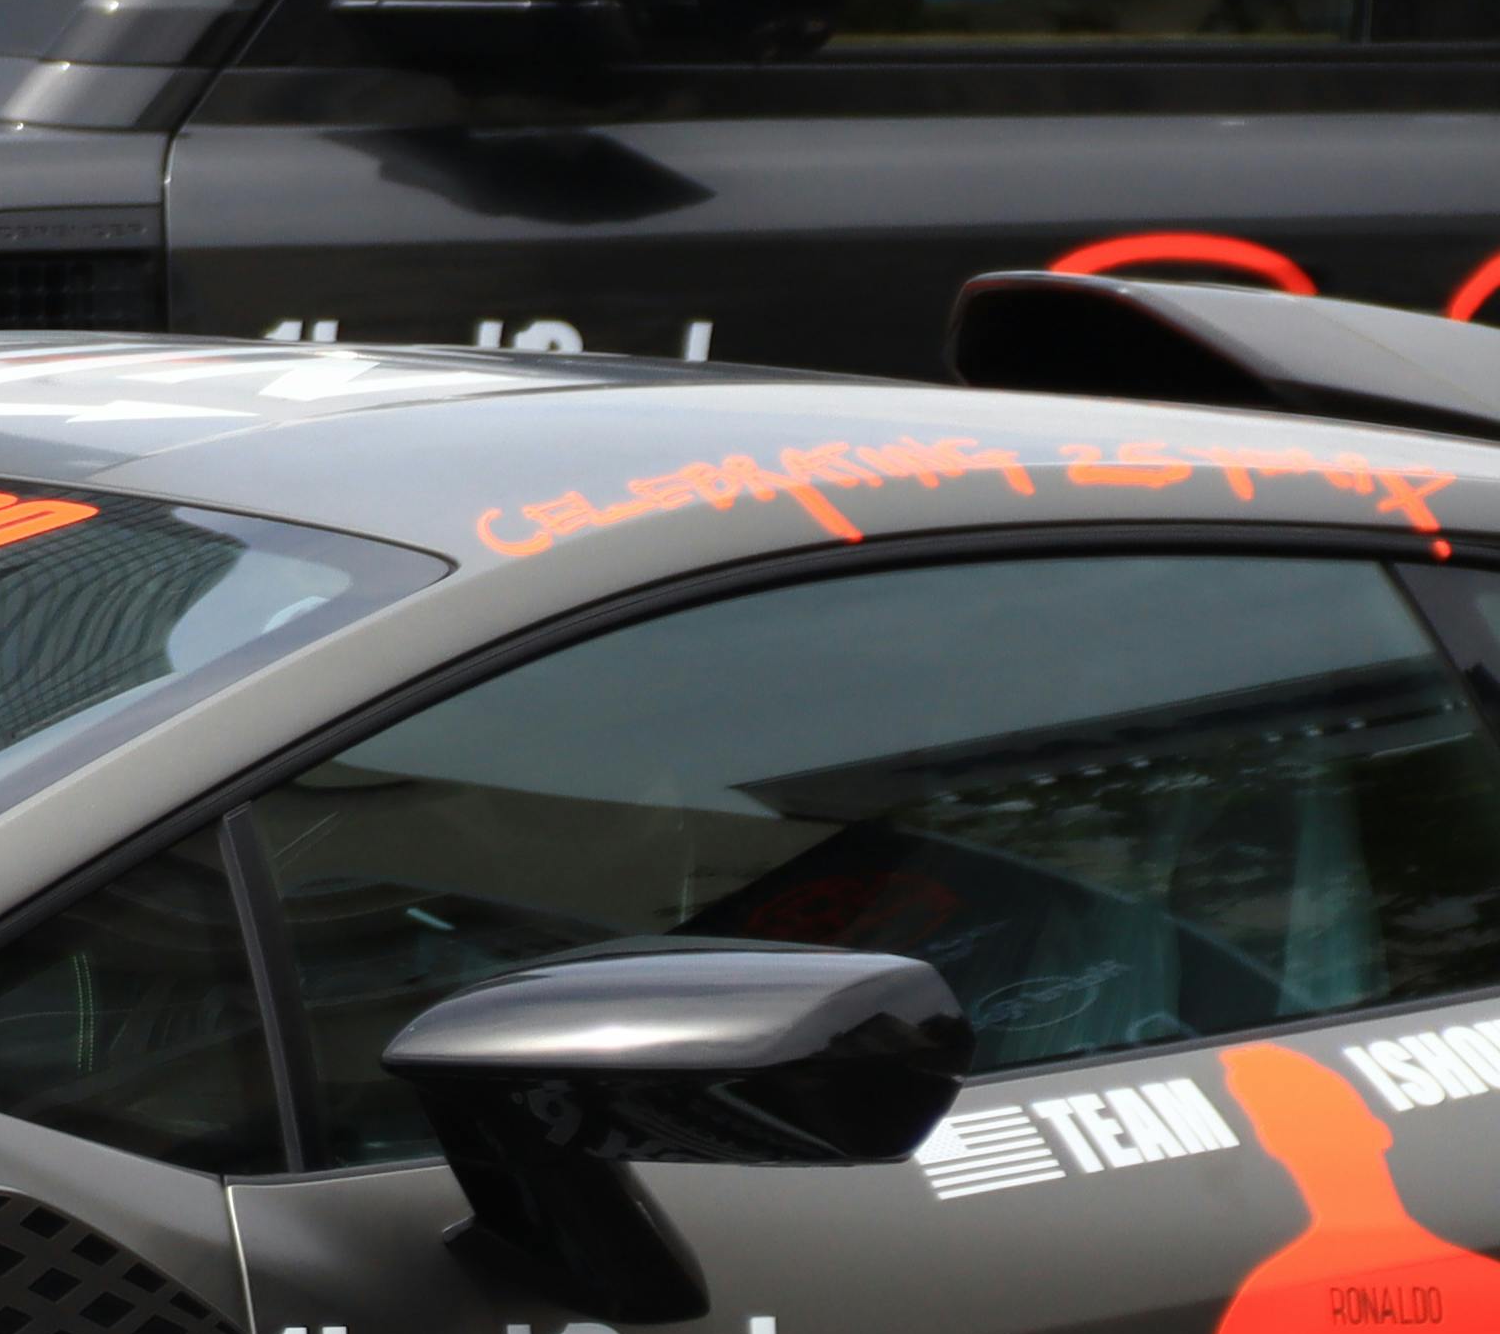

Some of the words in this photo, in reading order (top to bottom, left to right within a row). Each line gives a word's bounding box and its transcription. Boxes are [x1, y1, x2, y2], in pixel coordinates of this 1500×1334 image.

[1031, 1077, 1240, 1174] TEAM
[1342, 1019, 1500, 1113] ISHO
[1329, 1286, 1443, 1326] RONALDO
